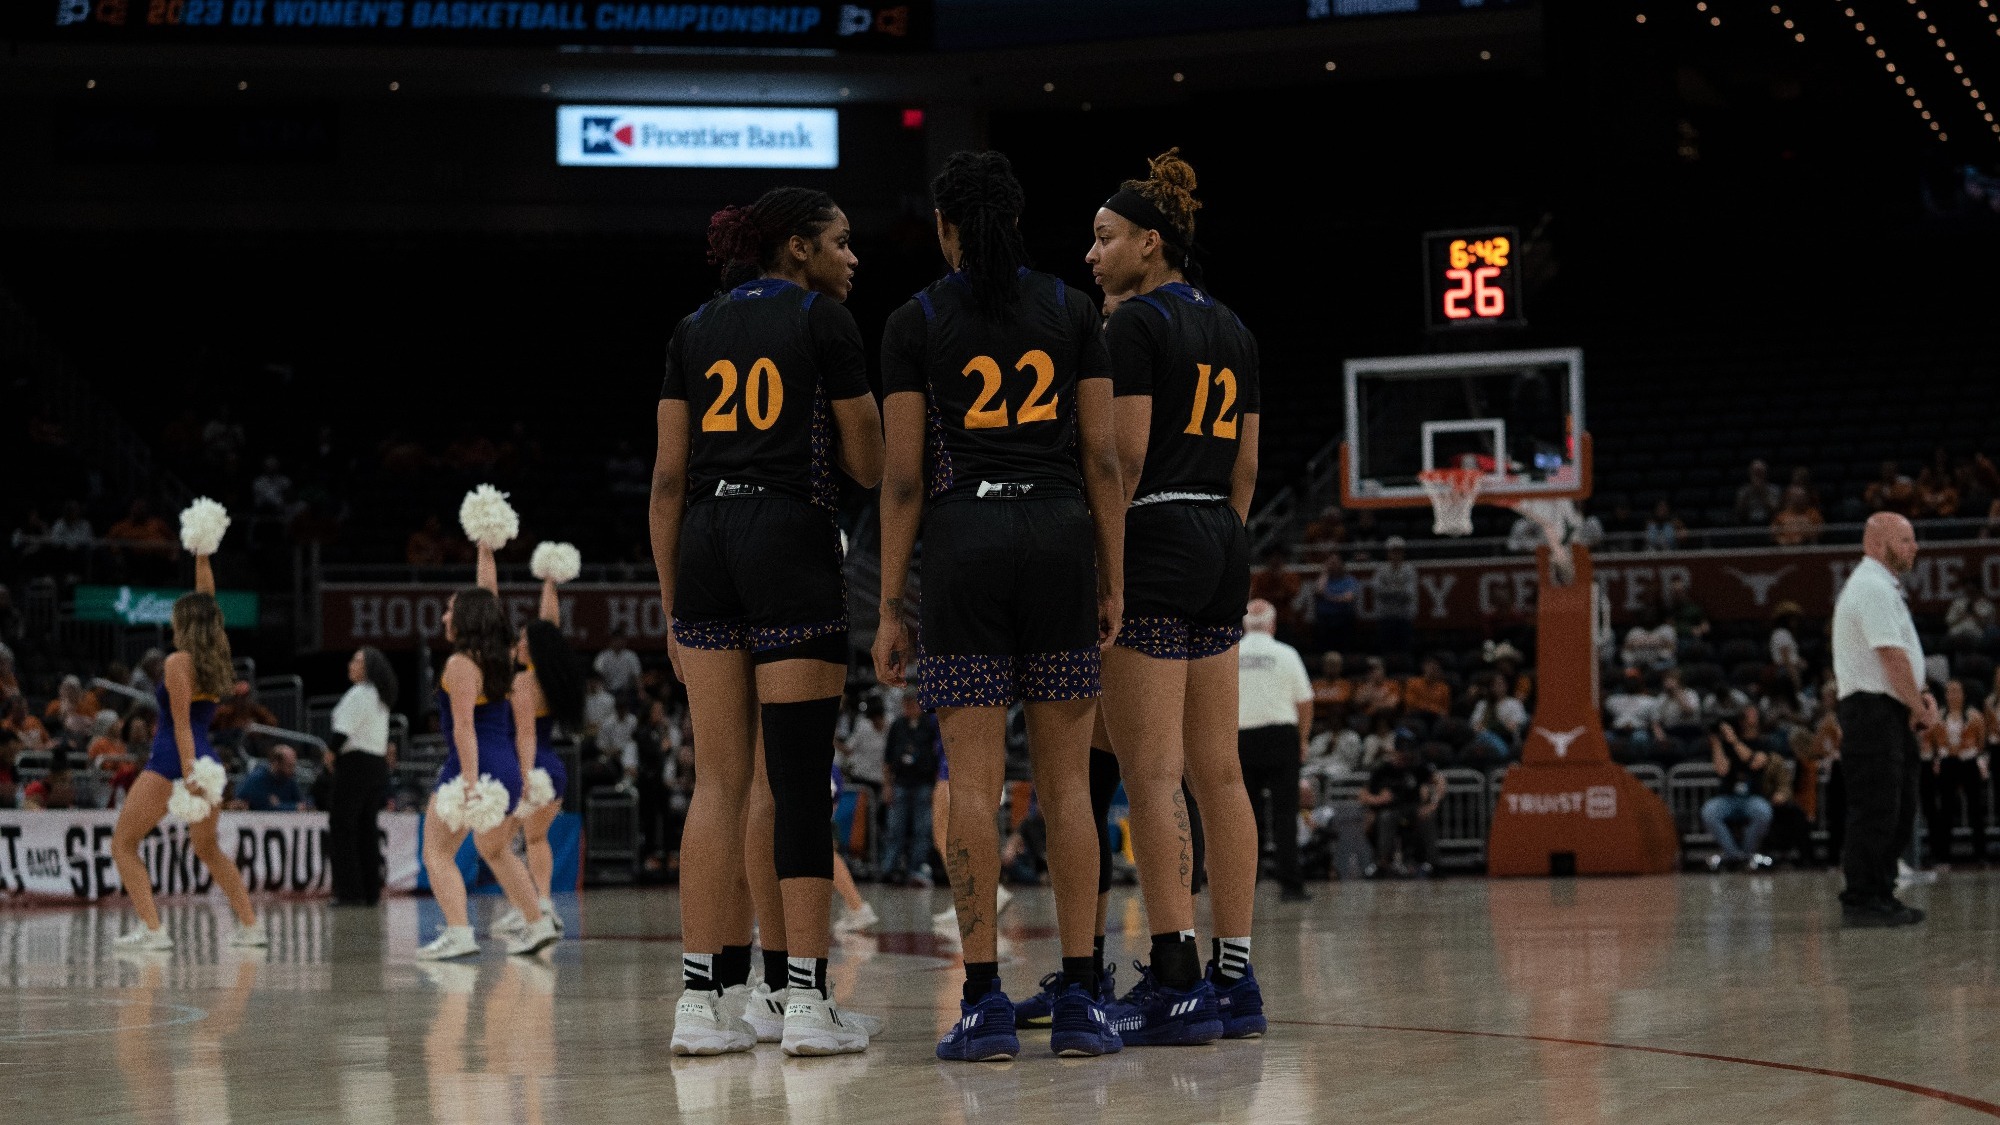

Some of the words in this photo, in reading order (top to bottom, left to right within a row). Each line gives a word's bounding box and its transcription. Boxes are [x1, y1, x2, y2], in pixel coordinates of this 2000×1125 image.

[146, 0, 223, 27] 2023
[273, 0, 403, 28] WOMEN'S
[411, 1, 588, 30] BASKETBALL
[595, 4, 821, 33] CHAMPIONSHIP
[641, 123, 739, 148] Frontier
[747, 123, 813, 148] Bank
[1449, 236, 1510, 269] 6:42
[1443, 266, 1505, 319] 26
[702, 357, 784, 432] 20
[962, 349, 1059, 429] 22
[1183, 362, 1238, 440] 12
[1478, 566, 1693, 615] CETER
[350, 595, 446, 638] HOO
[1506, 792, 1585, 815] TRUIST
[26, 847, 62, 877] AND
